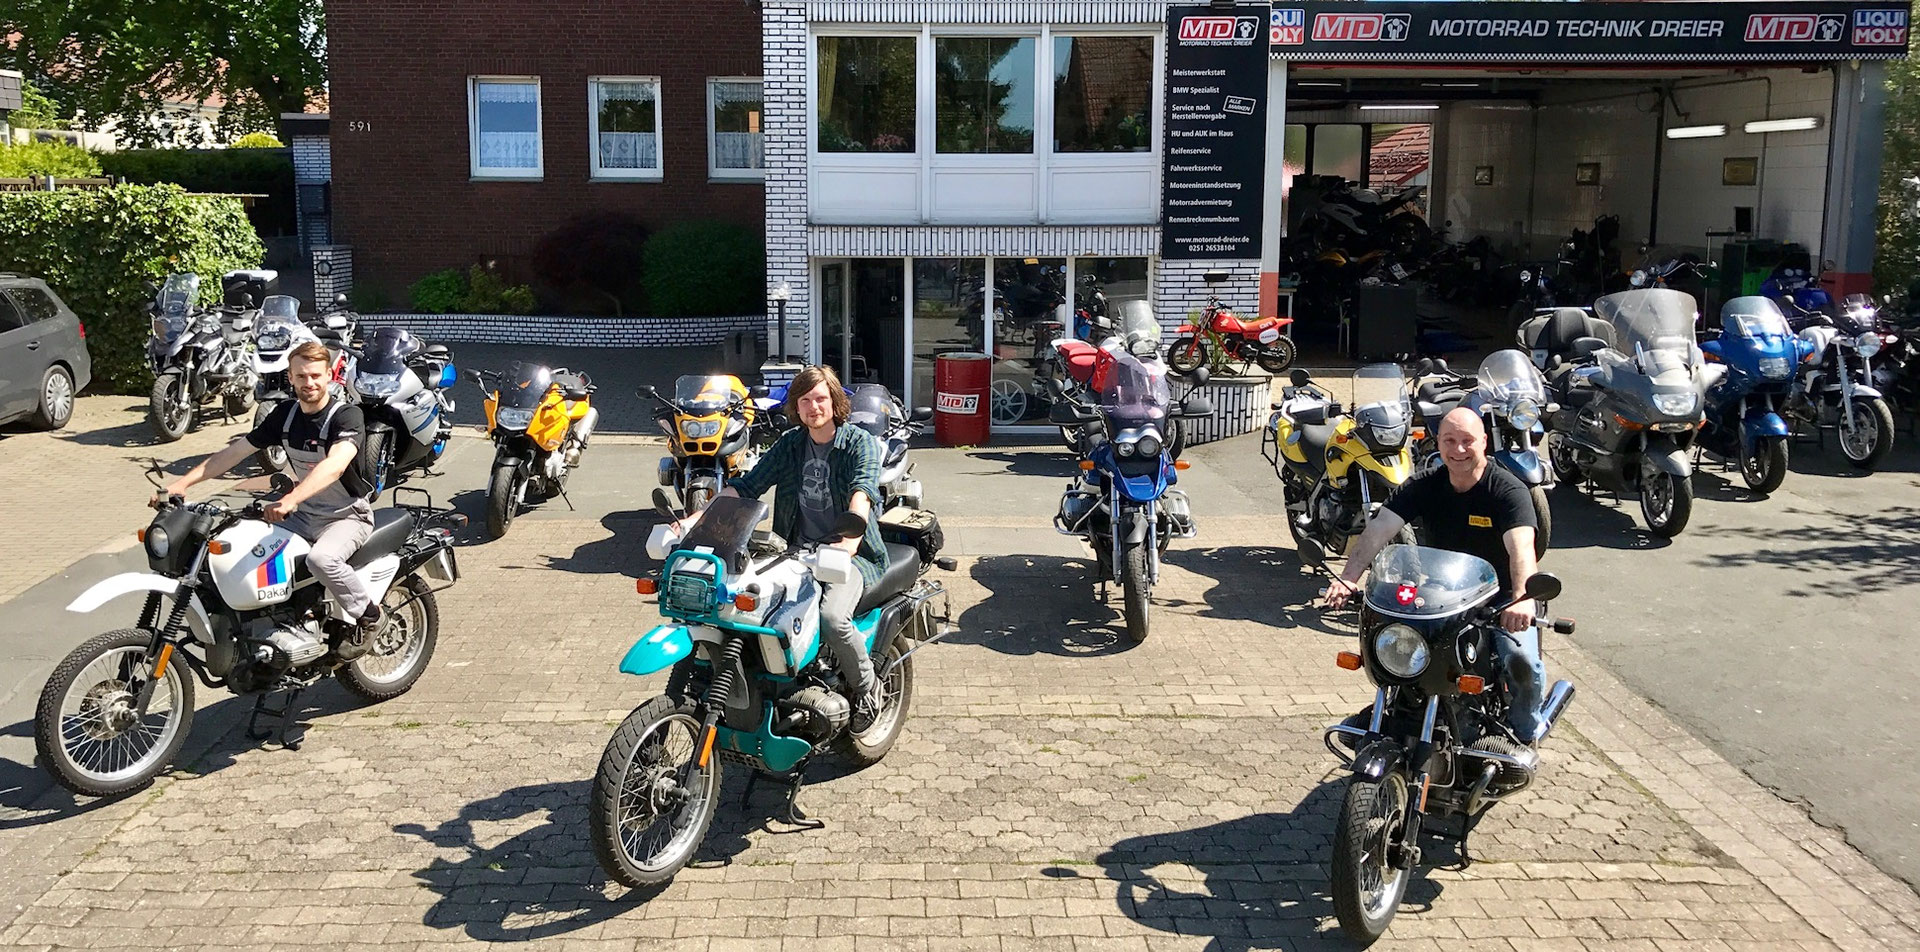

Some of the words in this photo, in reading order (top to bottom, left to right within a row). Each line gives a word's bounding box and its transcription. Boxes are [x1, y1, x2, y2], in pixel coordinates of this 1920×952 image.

[1271, 11, 1301, 26] QUI
[1856, 11, 1904, 26] LIQUI
[1182, 19, 1233, 38] MTD
[1315, 17, 1380, 38] MTD
[1429, 19, 1549, 37] MOTORRAD
[1555, 20, 1645, 37] TECHNIK
[1650, 20, 1724, 37] DREIER
[1750, 17, 1812, 39] MTD
[1270, 27, 1301, 43] OLY
[1856, 28, 1905, 43] MOLY
[1190, 86, 1220, 95] Spezialist
[1171, 113, 1227, 121] Herstellervorgabe
[349, 121, 371, 131] 591
[1170, 147, 1212, 155] Reifenservice
[1170, 164, 1223, 172] Fahrwerksservice
[1169, 182, 1242, 190] Motoreninstandsetzung
[1169, 199, 1233, 207] Motorradvermietung
[1174, 236, 1250, 244] www.motorrad-dreier.de
[1188, 244, 1204, 252] 0251
[1205, 244, 1236, 252] 26538104
[269, 539, 283, 551] Paris
[257, 587, 289, 600] Dakar
